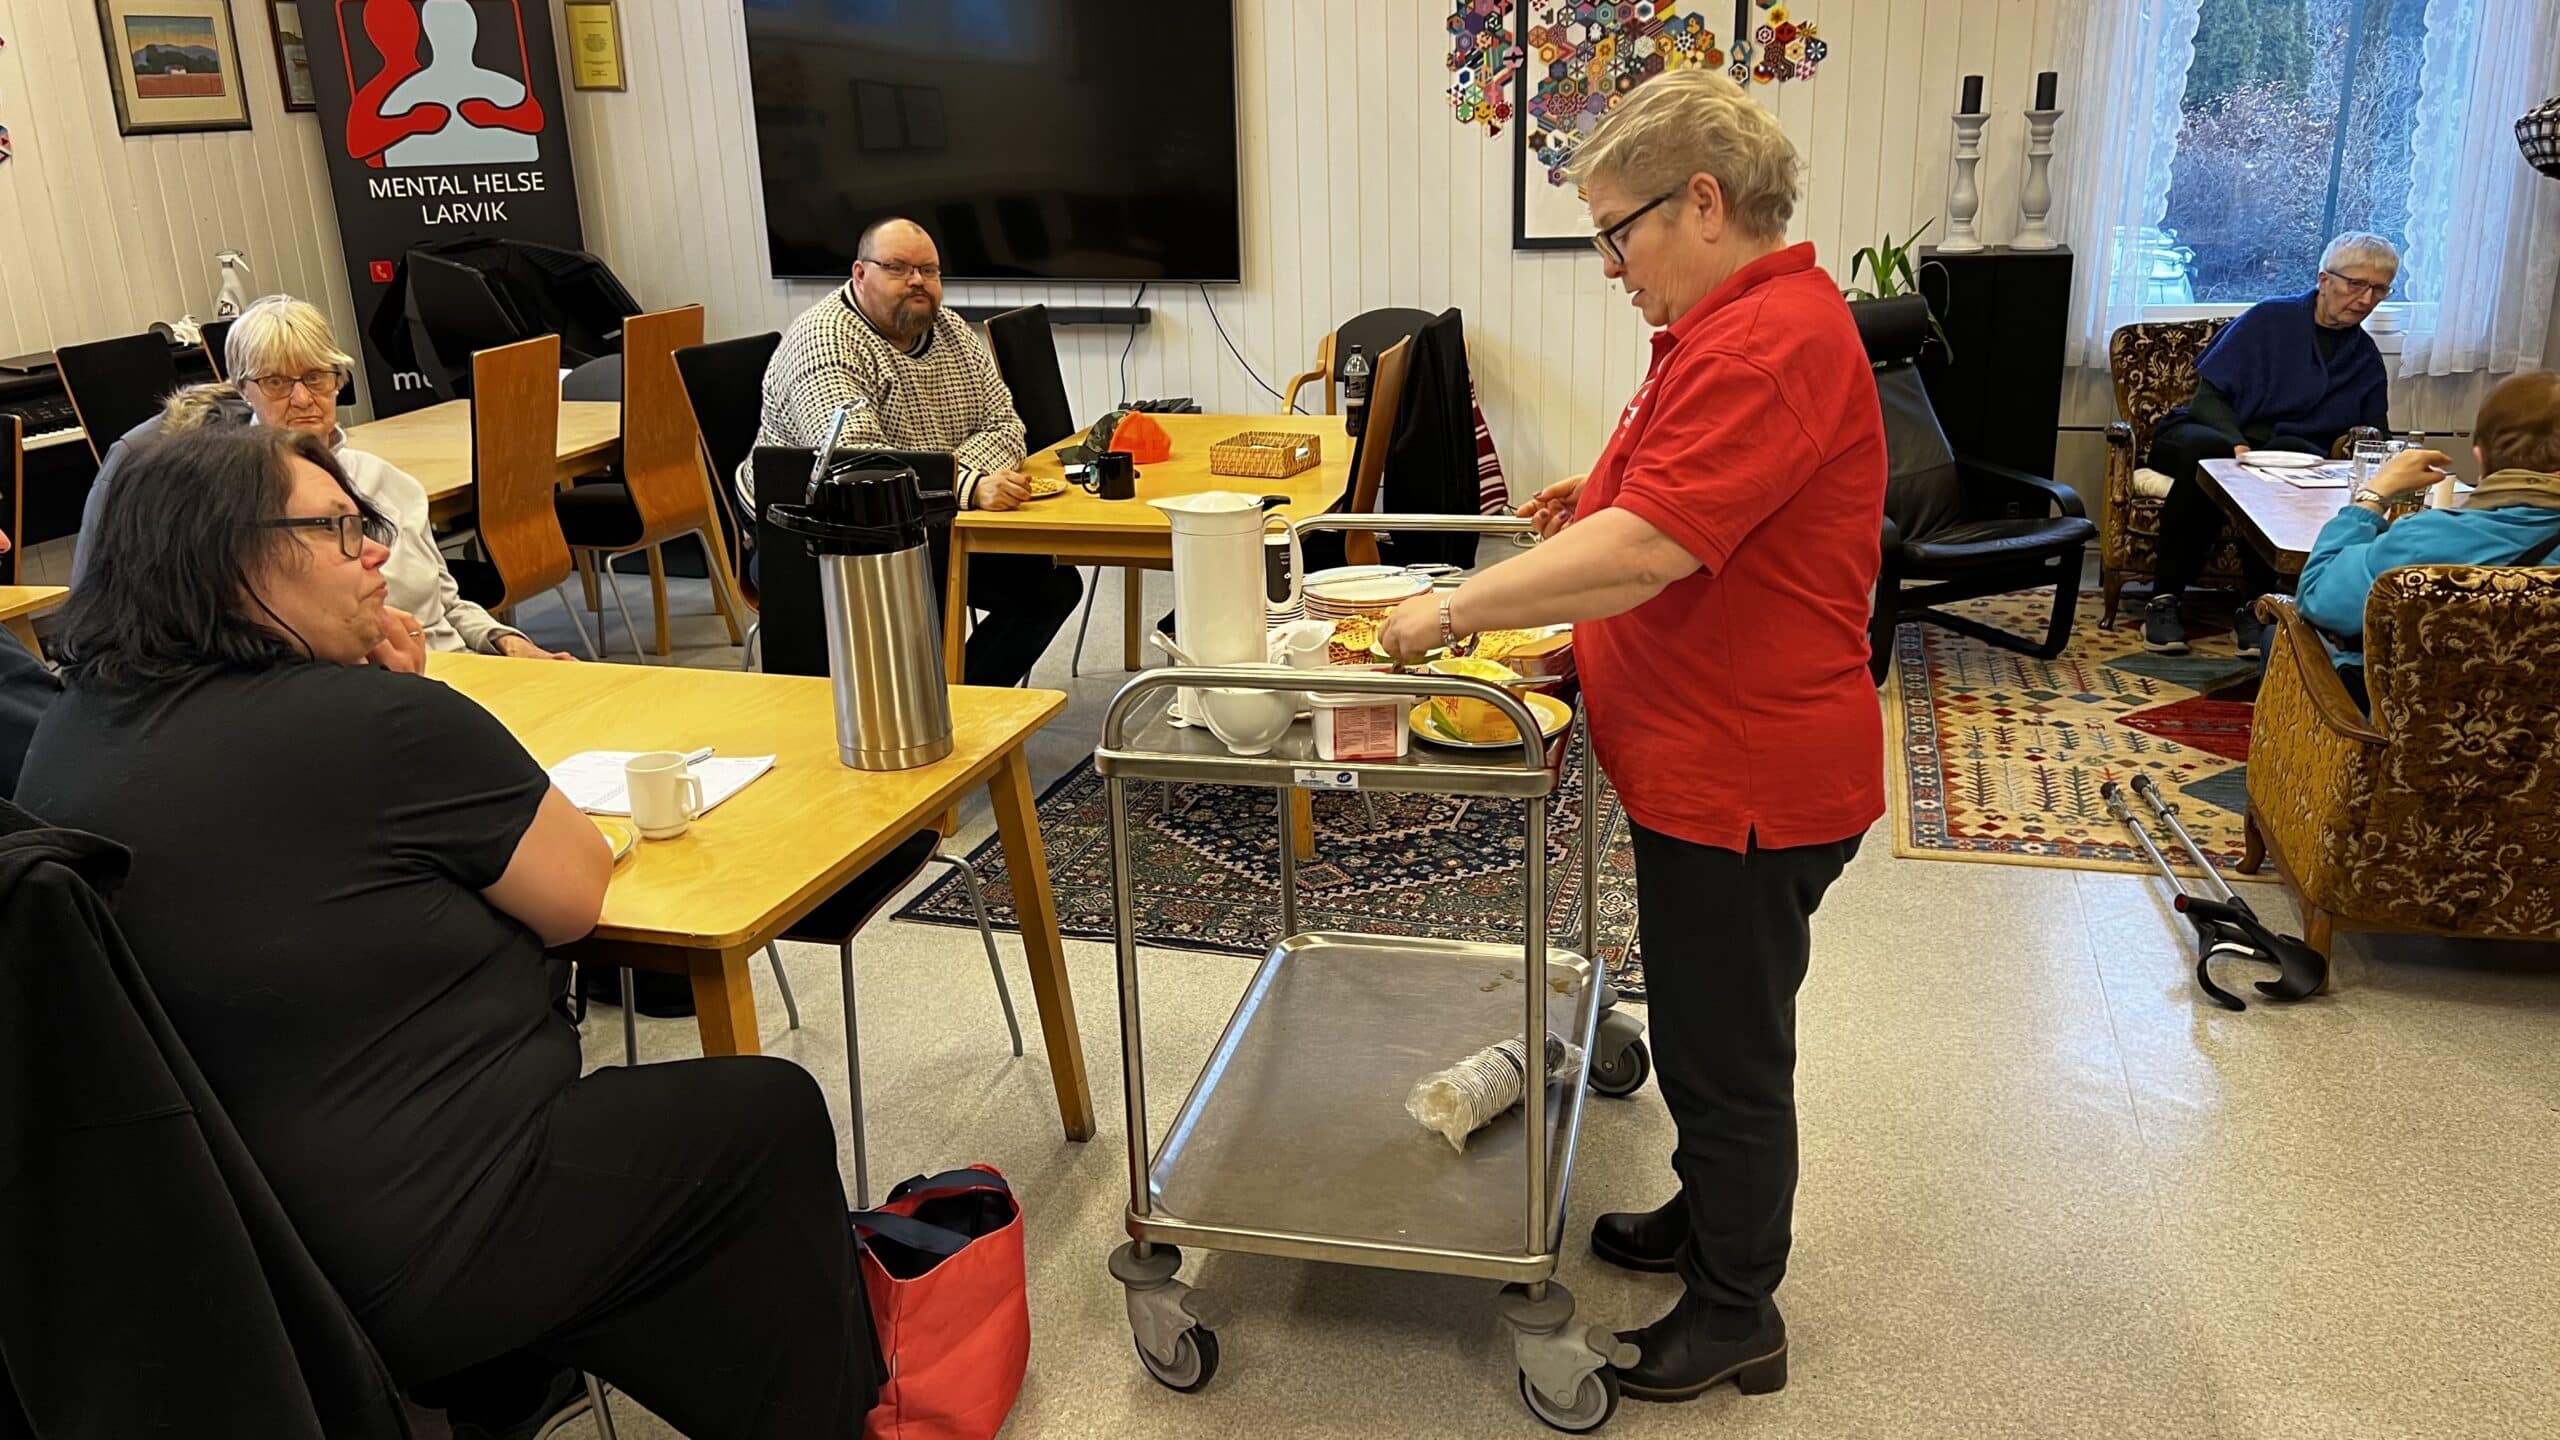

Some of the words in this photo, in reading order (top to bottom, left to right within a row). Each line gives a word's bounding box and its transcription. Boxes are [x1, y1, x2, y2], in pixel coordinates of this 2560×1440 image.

[368, 175, 469, 198] MENTAL
[473, 171, 545, 194] HELSE
[422, 201, 508, 224] LARVIK
